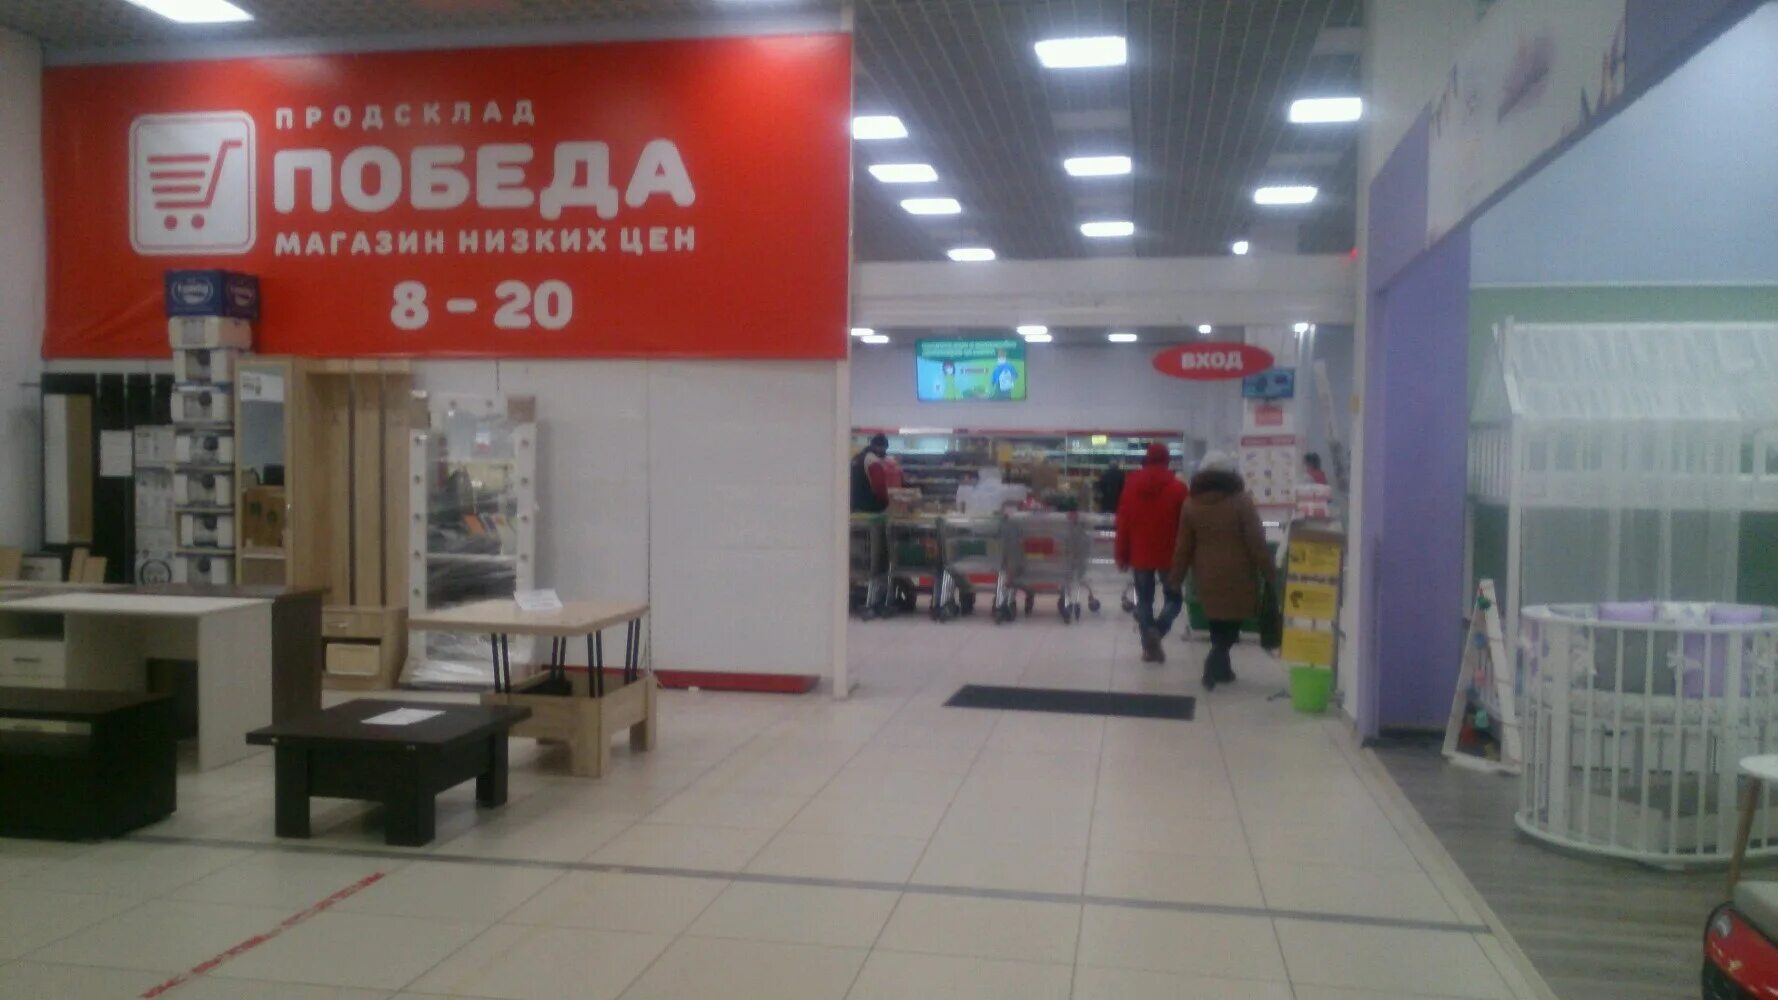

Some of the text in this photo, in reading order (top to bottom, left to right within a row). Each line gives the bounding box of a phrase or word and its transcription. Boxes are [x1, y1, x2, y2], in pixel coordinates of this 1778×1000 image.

[275, 99, 535, 131] ПРОДСКЛАД
[273, 138, 696, 220] ПОБЕДА
[274, 226, 696, 256] МАГАЗИН НИЗКИХ ЦЕН
[390, 280, 429, 330] 8
[493, 279, 574, 330] 20
[1180, 350, 1245, 371] ВХОД
